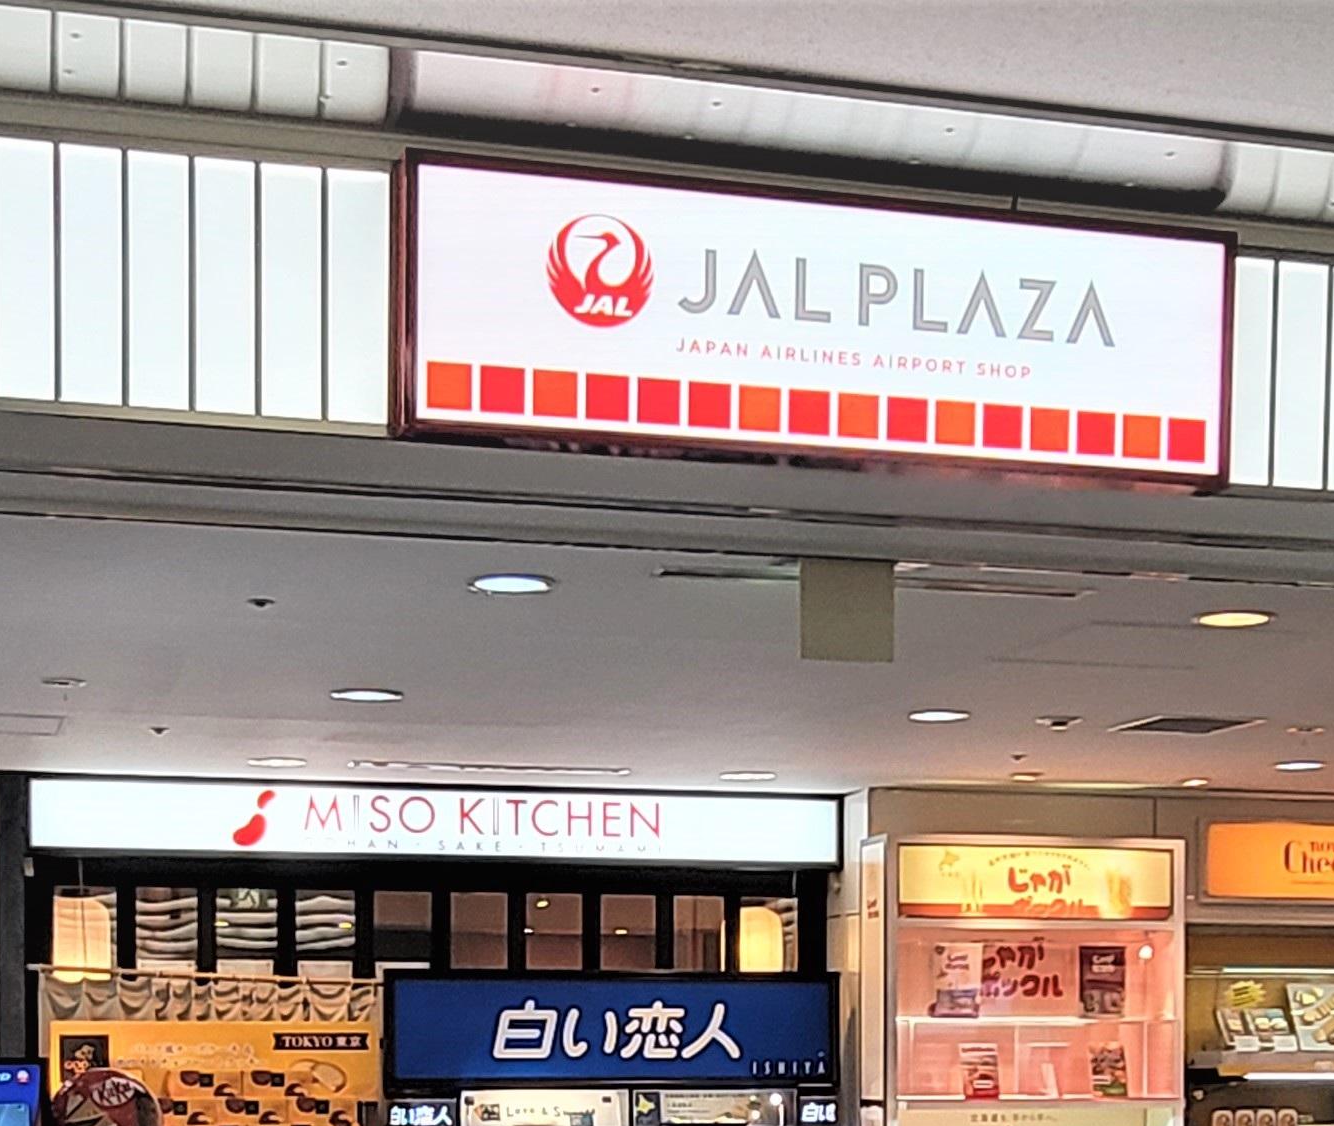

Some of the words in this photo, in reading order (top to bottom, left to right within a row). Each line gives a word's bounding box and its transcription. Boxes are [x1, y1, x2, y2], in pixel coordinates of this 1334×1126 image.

[574, 294, 634, 317] JAL
[678, 248, 831, 323] JAL
[858, 263, 1116, 348] PLAZA
[676, 337, 749, 357] JAPAN
[761, 345, 862, 366] AIRLINES
[873, 354, 966, 375] AIRPORT
[976, 363, 1033, 379] SHOP
[304, 794, 436, 833] MISO
[459, 798, 660, 838] KITCHEN
[438, 840, 501, 851] SAKE
[1008, 865, 1071, 894] じゃが
[282, 1035, 333, 1048] TOKYO
[492, 999, 742, 1059] 白い恋人
[751, 1059, 826, 1075] ISHIYA
